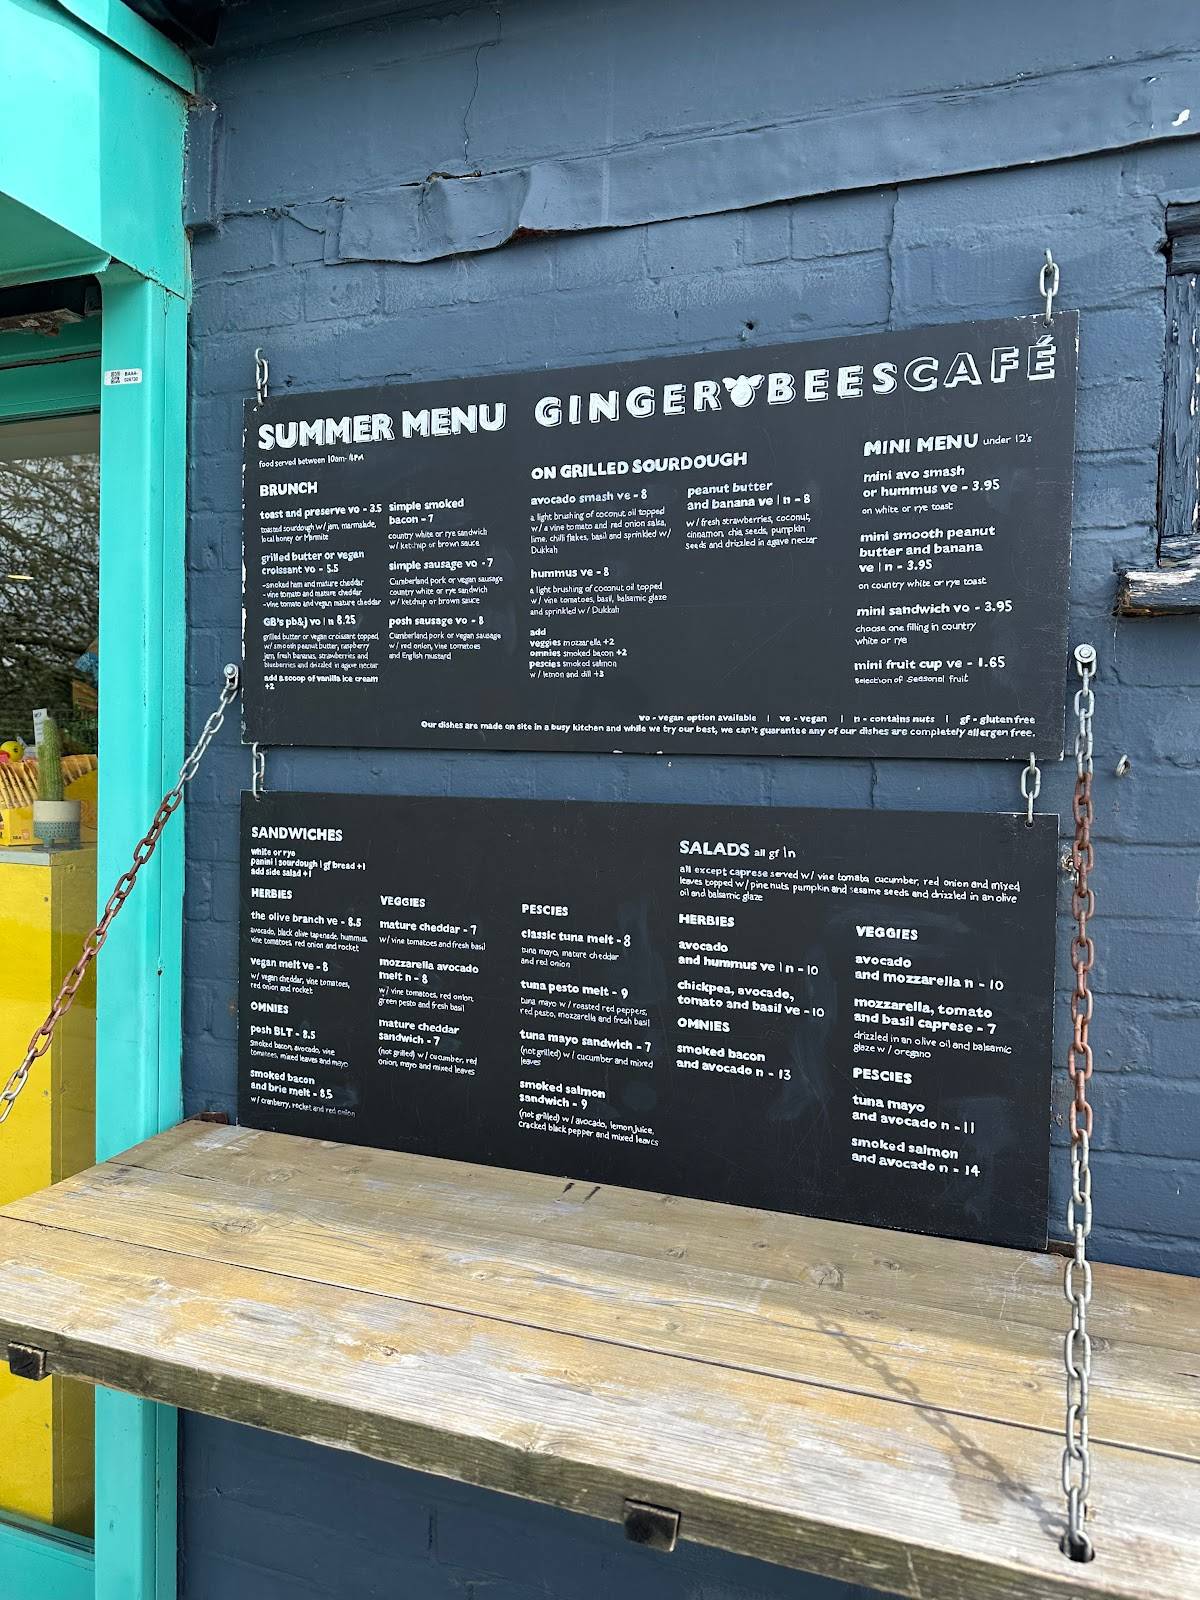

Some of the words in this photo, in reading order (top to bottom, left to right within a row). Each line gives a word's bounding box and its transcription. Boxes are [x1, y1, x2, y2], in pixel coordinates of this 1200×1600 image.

[534, 380, 722, 427] GINGER
[258, 413, 395, 450] SUMMER
[402, 402, 506, 438] MENU
[863, 438, 910, 456] MINI
[916, 433, 978, 452] MENU
[983, 434, 1011, 445] under
[1015, 433, 1032, 442] 12's
[258, 459, 274, 468] food
[531, 465, 556, 479] ON
[559, 460, 629, 478] GRILLED
[631, 451, 747, 473] SOURDOUGH
[863, 469, 892, 482] mini
[895, 470, 919, 480] avo
[922, 464, 965, 478] smash
[259, 481, 317, 496] BRUNCH
[862, 489, 877, 497] or
[880, 484, 937, 496] hummus
[940, 483, 958, 493] ve
[972, 478, 1000, 491] 3.95
[530, 493, 576, 505] avocado
[579, 491, 613, 503] smash
[616, 492, 631, 500] ve
[640, 488, 647, 499] 8
[259, 509, 283, 519] toast
[285, 507, 302, 517] and
[304, 506, 346, 519] preserve
[347, 505, 360, 514] vo
[388, 500, 421, 513] simple
[424, 497, 464, 510] smoked
[874, 504, 899, 514] white
[913, 504, 928, 513] rye
[931, 501, 953, 510] toast
[389, 515, 418, 525] bacon
[427, 513, 433, 522] 7
[387, 532, 414, 543] country
[414, 529, 434, 538] white
[444, 530, 456, 538] rye
[456, 527, 487, 536] sandwich
[530, 545, 558, 554] Dukkah
[388, 560, 421, 572] simple
[423, 560, 463, 571] sausage
[465, 559, 477, 567] vo
[486, 557, 493, 567] 7
[530, 568, 577, 578] hummus
[579, 568, 593, 576] ve
[603, 566, 609, 576] 8
[529, 647, 561, 657] omnies
[562, 648, 590, 657] smoked
[592, 649, 614, 657] bacon
[615, 648, 627, 656] +2
[854, 659, 882, 670] mini
[885, 659, 916, 669] fruit
[918, 660, 942, 671] cup
[946, 659, 962, 668] ve
[978, 655, 1005, 668] 1.65
[657, 714, 684, 723] vegan
[686, 713, 715, 723] option
[717, 713, 757, 723] available
[959, 714, 970, 725] gf
[979, 714, 1013, 725] gluten
[1013, 714, 1035, 724] free
[420, 720, 437, 728] Our
[437, 720, 463, 729] dishes
[480, 722, 503, 730] made
[516, 722, 532, 730] site
[534, 722, 542, 730] in
[550, 723, 570, 733] busy
[572, 723, 604, 731] kitchen
[605, 724, 621, 732] and
[623, 724, 646, 732] while
[662, 724, 677, 735] try
[695, 725, 718, 735] best,
[735, 726, 758, 734] can't
[759, 726, 806, 736] guarantee
[808, 728, 826, 736] any
[827, 726, 838, 735] of
[859, 726, 889, 735] dishes
[909, 727, 966, 738] completely
[967, 727, 1008, 739] allergen
[1009, 727, 1035, 737] free.
[251, 826, 342, 841] SANDWICHES
[679, 839, 750, 857] SALADS
[753, 848, 765, 856] all
[768, 848, 780, 860] gf
[251, 887, 292, 899] HERBIES
[380, 895, 425, 907] VEGGIES
[521, 903, 568, 916] PESCIES
[250, 910, 266, 920] the
[268, 912, 290, 922] olive
[292, 913, 324, 924] branch
[326, 917, 338, 925] ve
[347, 916, 361, 927] 8.5
[678, 913, 734, 927] HERBIES
[379, 920, 417, 931] mature
[418, 922, 460, 934] cheddar
[470, 924, 477, 935] 7
[855, 925, 918, 940] VEGGIES
[378, 934, 390, 944] w/
[391, 936, 405, 944] vine
[406, 938, 437, 947] tomatoes
[438, 940, 451, 948] and
[451, 940, 469, 949] fresh
[470, 941, 485, 951] basil
[520, 928, 556, 940] classic
[558, 931, 584, 942] tuna
[586, 934, 613, 944] melt
[623, 934, 630, 947] 8
[678, 940, 728, 952] avocado
[379, 958, 434, 970] mozzarella
[436, 963, 479, 973] avocado
[677, 954, 700, 965] and
[703, 955, 757, 970] hummus
[759, 962, 775, 971] ve
[785, 964, 794, 973] n
[807, 964, 818, 975] 10
[378, 971, 403, 981] melt
[405, 973, 411, 981] n
[421, 973, 428, 984] 8
[677, 979, 734, 996] chickpea,
[737, 987, 794, 1002] avocado,
[250, 1001, 288, 1014] OMNIES
[250, 1025, 272, 1035] posh
[273, 1025, 293, 1037] BLT
[302, 1029, 315, 1039] 8.5
[677, 1017, 730, 1032] OMNIES
[852, 1067, 912, 1084] PESCIES
[851, 1137, 905, 1152] smoked
[908, 1144, 958, 1159] salmon
[851, 1152, 876, 1164] and
[878, 1156, 935, 1171] avocado
[939, 1164, 948, 1173] n
[965, 1164, 980, 1177] 14
